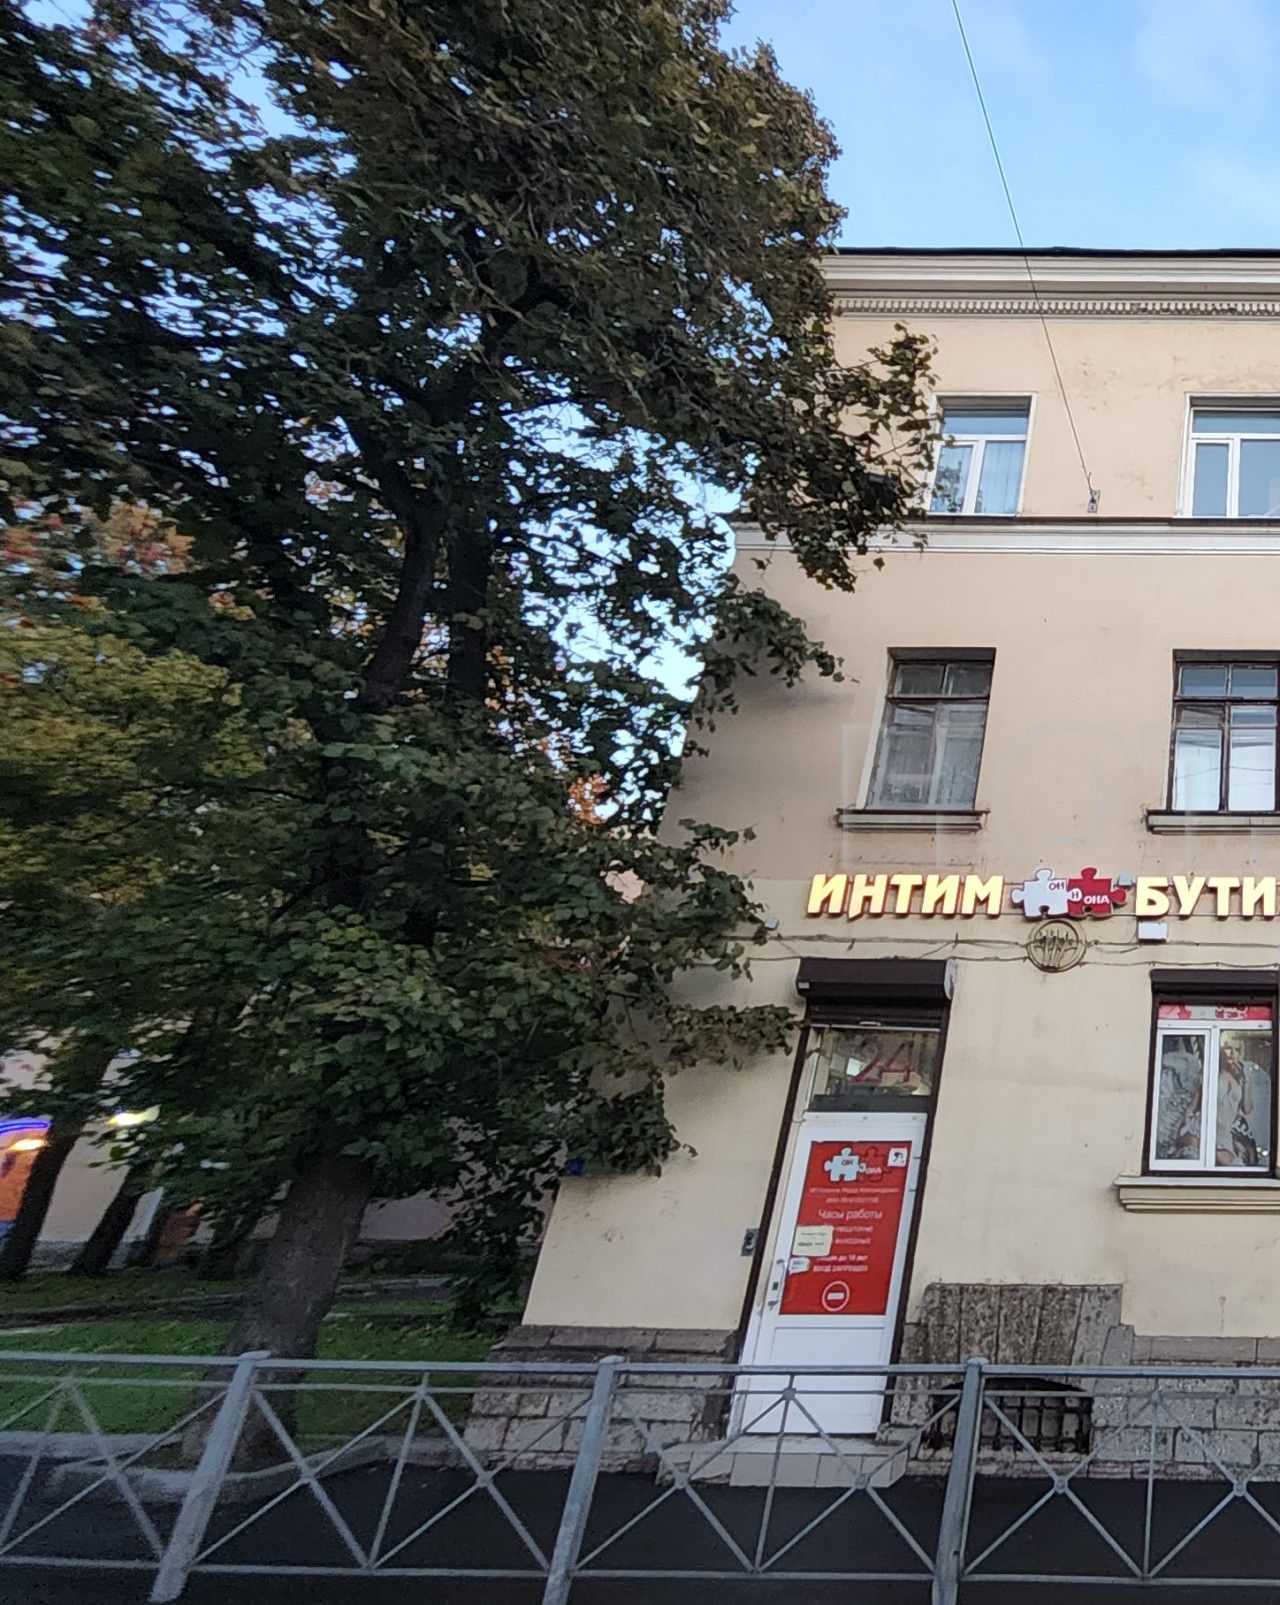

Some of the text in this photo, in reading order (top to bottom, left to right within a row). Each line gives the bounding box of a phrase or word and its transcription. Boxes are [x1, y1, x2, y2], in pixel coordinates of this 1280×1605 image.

[806, 874, 1005, 919] ИНТИМ
[1048, 882, 1064, 890] ОН
[1083, 895, 1110, 904] ОНА
[818, 1209, 882, 1220] Часы работы
